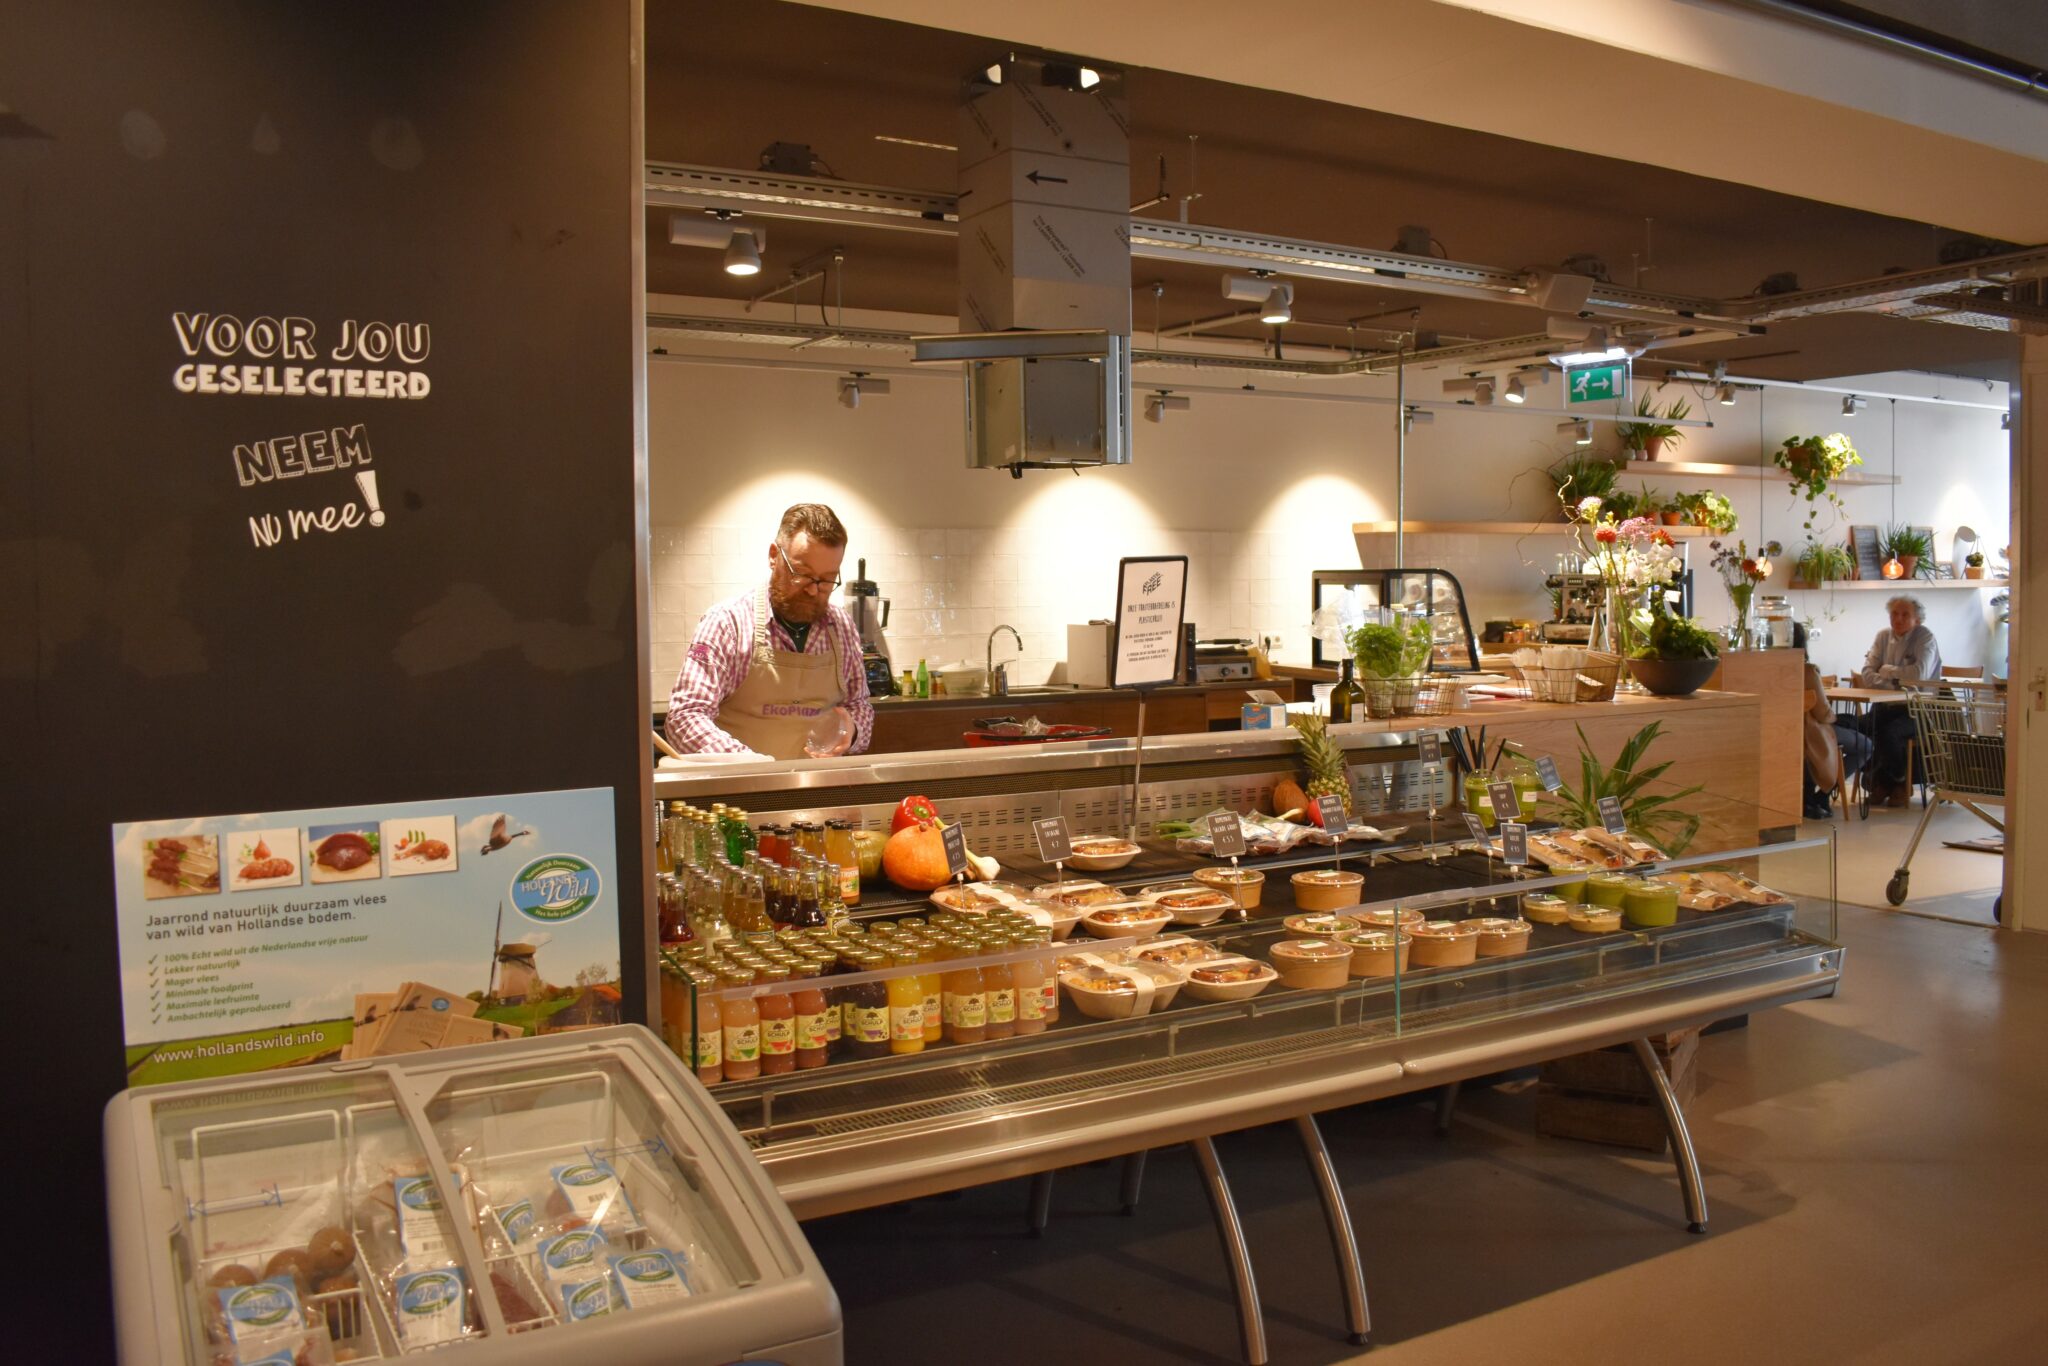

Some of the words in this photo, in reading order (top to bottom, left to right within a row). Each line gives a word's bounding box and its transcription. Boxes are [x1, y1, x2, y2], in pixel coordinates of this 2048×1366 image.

[172, 312, 317, 360] VOOR
[332, 319, 431, 364] JOU
[173, 363, 431, 400] GESELECTEERD
[232, 423, 372, 487] NEEM
[146, 910, 209, 927] Jaarrond
[213, 904, 279, 921] natuurlijk
[284, 898, 349, 913] duurzaam
[353, 894, 387, 906] vlees
[146, 929, 171, 941] van
[175, 924, 204, 938] wild
[209, 923, 232, 934] van
[237, 916, 304, 932] Hollandse
[308, 911, 356, 924] bodem.
[165, 951, 189, 963] 100%
[191, 950, 211, 960] Echt
[213, 947, 232, 957] wild
[234, 946, 246, 955] uit
[248, 945, 259, 953] de
[261, 939, 316, 952] Nederlandse
[318, 937, 337, 947] vrije
[339, 935, 368, 944] natuur
[164, 963, 194, 975] Lekker
[196, 959, 241, 972] natuurlijk
[165, 976, 194, 988] Mager
[196, 975, 219, 983] vlees
[166, 986, 208, 999] Minimale
[211, 982, 254, 994] foodprint
[166, 999, 212, 1011] Maximale
[213, 993, 260, 1005] leefruimte
[167, 1008, 227, 1023] Ambachtelijk
[229, 1000, 291, 1017] geproduceerd
[153, 1030, 325, 1063] www.hollandswild.info
[767, 1030, 790, 1038] SCHULP
